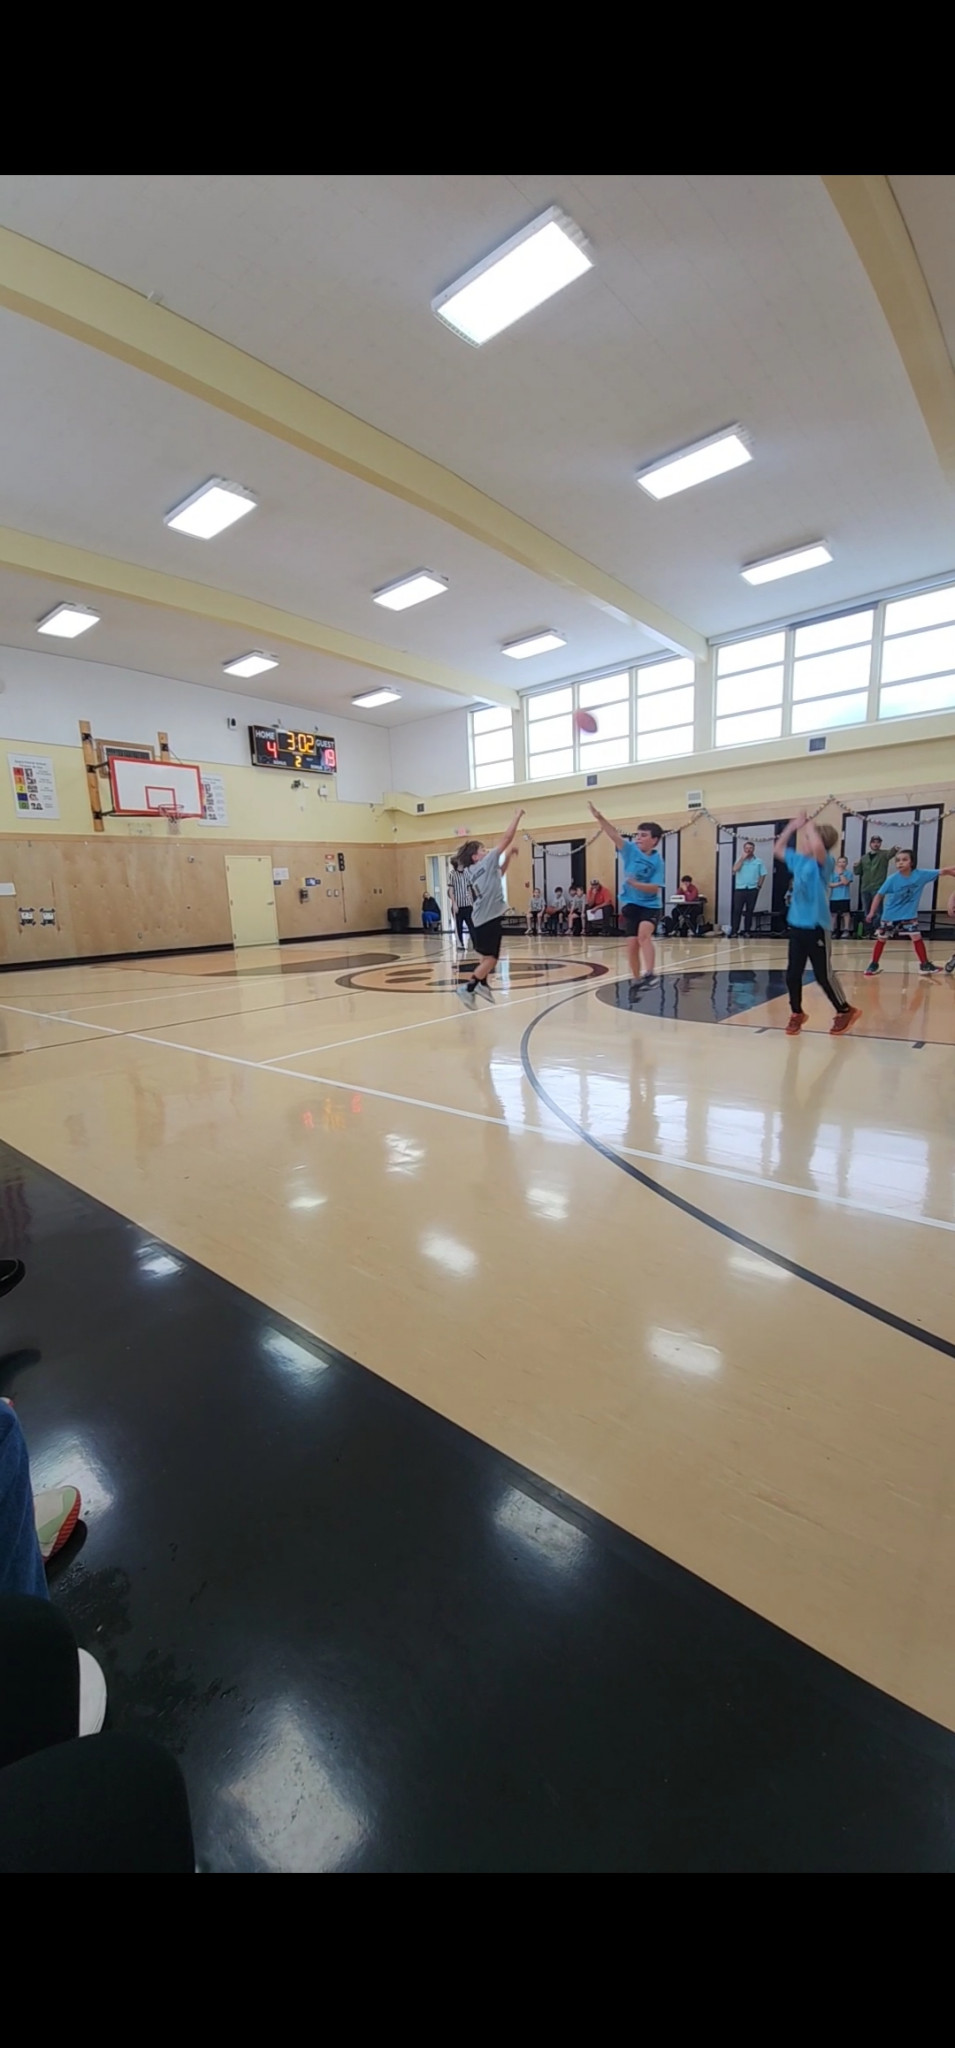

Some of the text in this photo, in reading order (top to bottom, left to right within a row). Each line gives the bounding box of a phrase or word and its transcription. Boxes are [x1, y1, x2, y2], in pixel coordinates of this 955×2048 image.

[255, 730, 275, 740] HOME
[316, 739, 335, 748] GUEST
[266, 741, 277, 759] 4
[295, 755, 302, 768] 2
